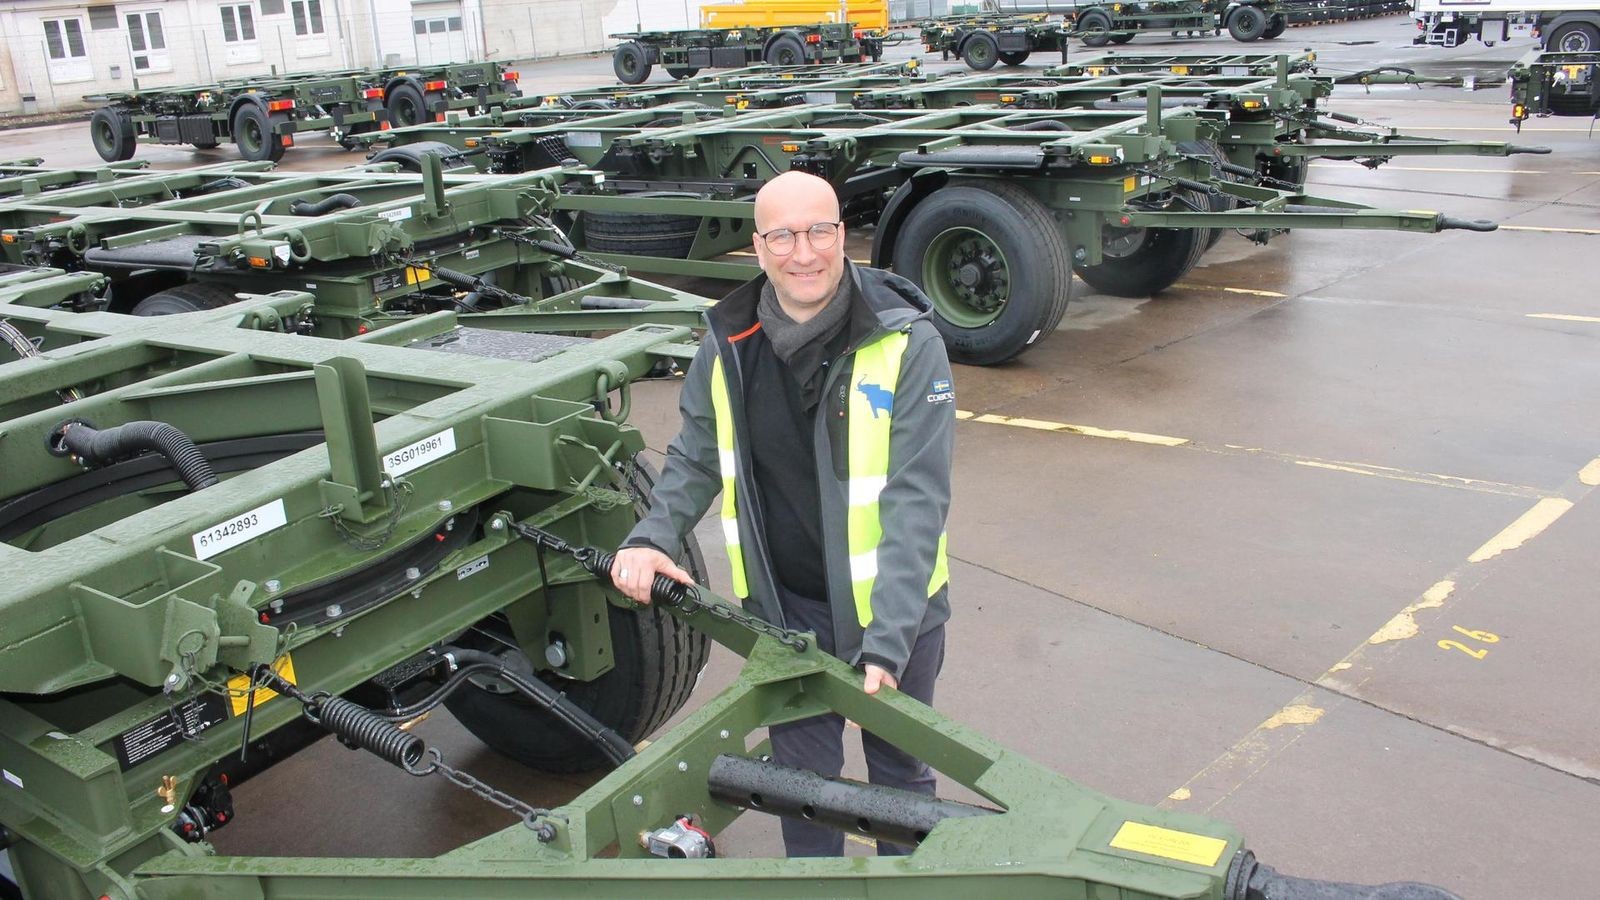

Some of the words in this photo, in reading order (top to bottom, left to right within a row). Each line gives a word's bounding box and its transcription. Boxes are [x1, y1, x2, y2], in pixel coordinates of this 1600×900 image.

[388, 437, 443, 469] 3SG019961
[200, 514, 259, 547] 61342893
[1437, 624, 1500, 660] 26
